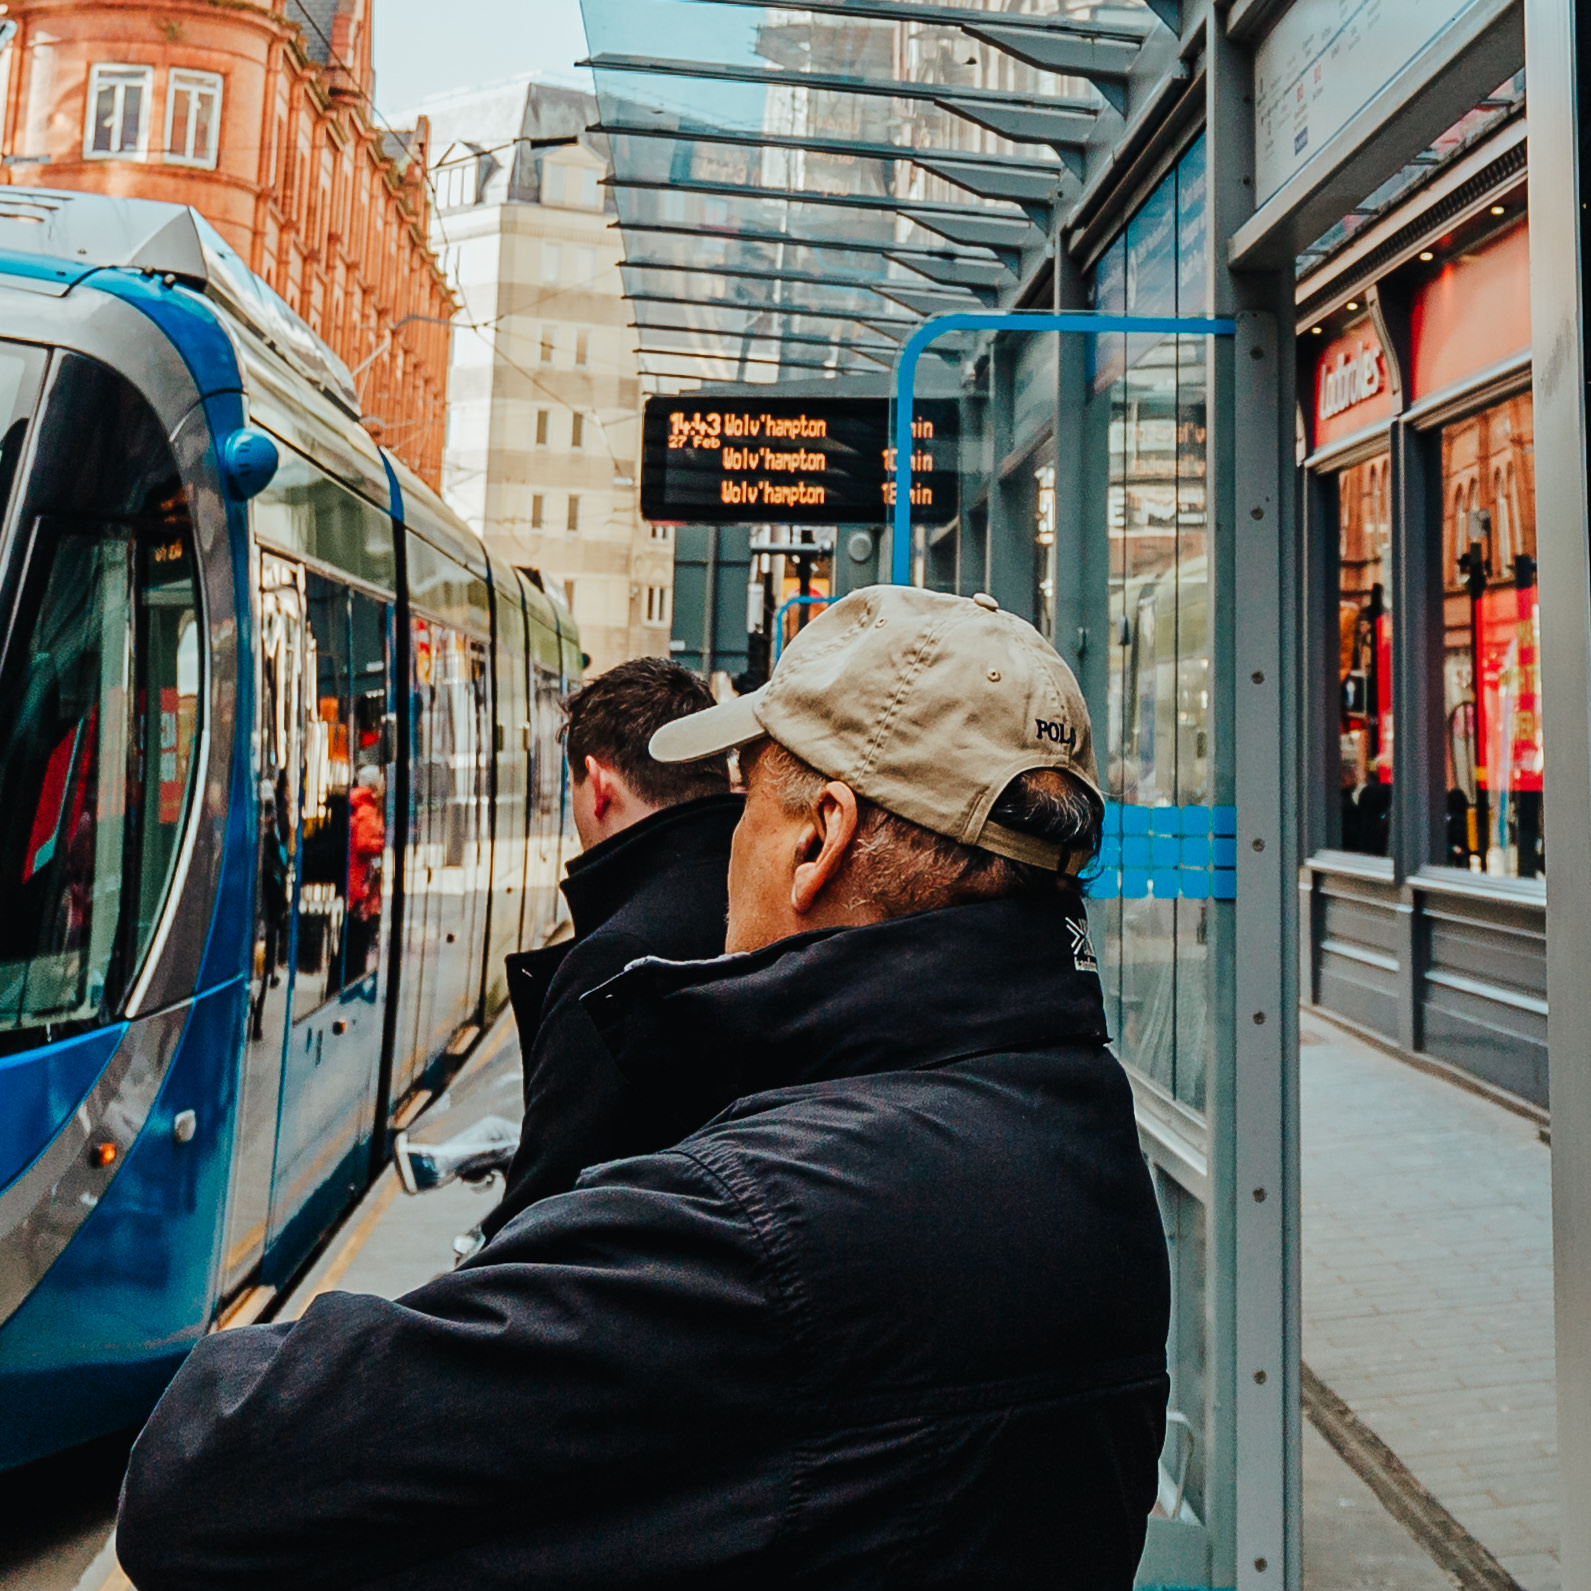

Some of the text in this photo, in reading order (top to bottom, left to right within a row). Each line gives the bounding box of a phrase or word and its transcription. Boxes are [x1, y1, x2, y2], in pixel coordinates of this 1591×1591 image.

[724, 413, 827, 440] Wolv'hampton
[668, 435, 721, 449] 27 Feb
[722, 447, 826, 473] Wolv'hampton
[721, 480, 825, 507] Wolv'hampton
